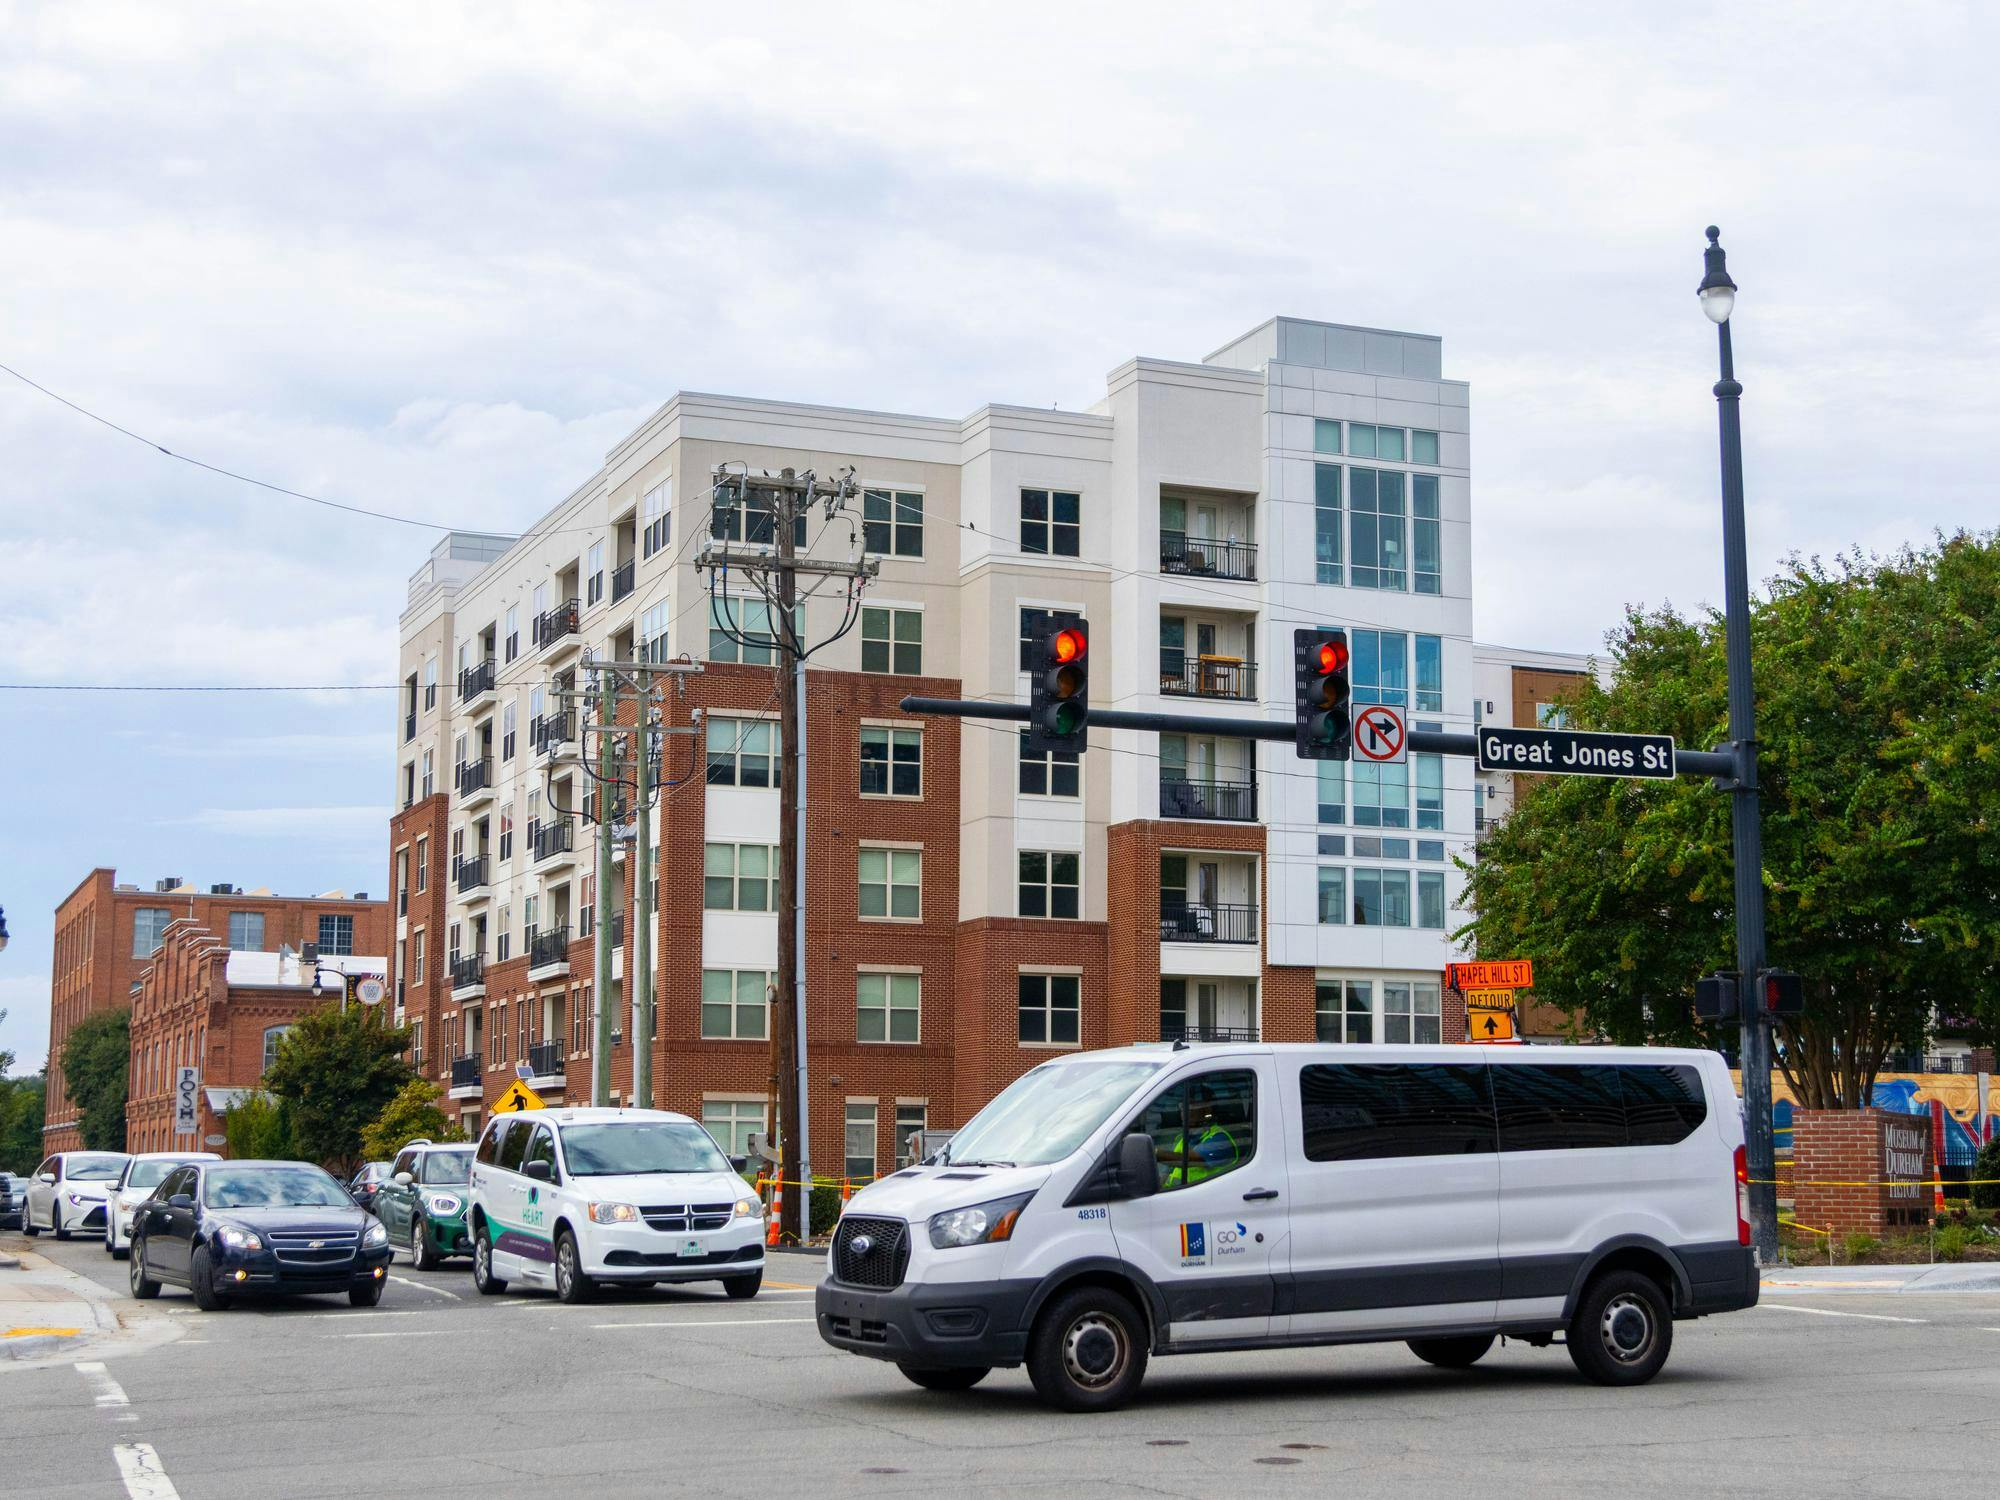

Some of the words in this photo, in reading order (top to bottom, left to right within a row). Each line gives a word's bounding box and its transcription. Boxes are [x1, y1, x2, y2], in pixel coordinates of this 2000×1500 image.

[1486, 736, 1552, 763] Great
[1563, 741, 1634, 768] Jones
[1642, 745, 1668, 769] St
[1456, 966, 1488, 984] CHAPEL
[1492, 966, 1511, 983] HILL
[1513, 965, 1523, 982] ST
[1470, 993, 1510, 1007] DETOUR
[180, 1069, 195, 1119] POSH
[1884, 1123, 1918, 1149] MUSEUM
[1919, 1128, 1927, 1156] of
[1885, 1147, 1924, 1176] DURHAM
[1889, 1174, 1921, 1199] HISTORY
[1077, 1208, 1106, 1220] 48318
[1217, 1231, 1237, 1244] GO
[1217, 1246, 1246, 1255] Durham
